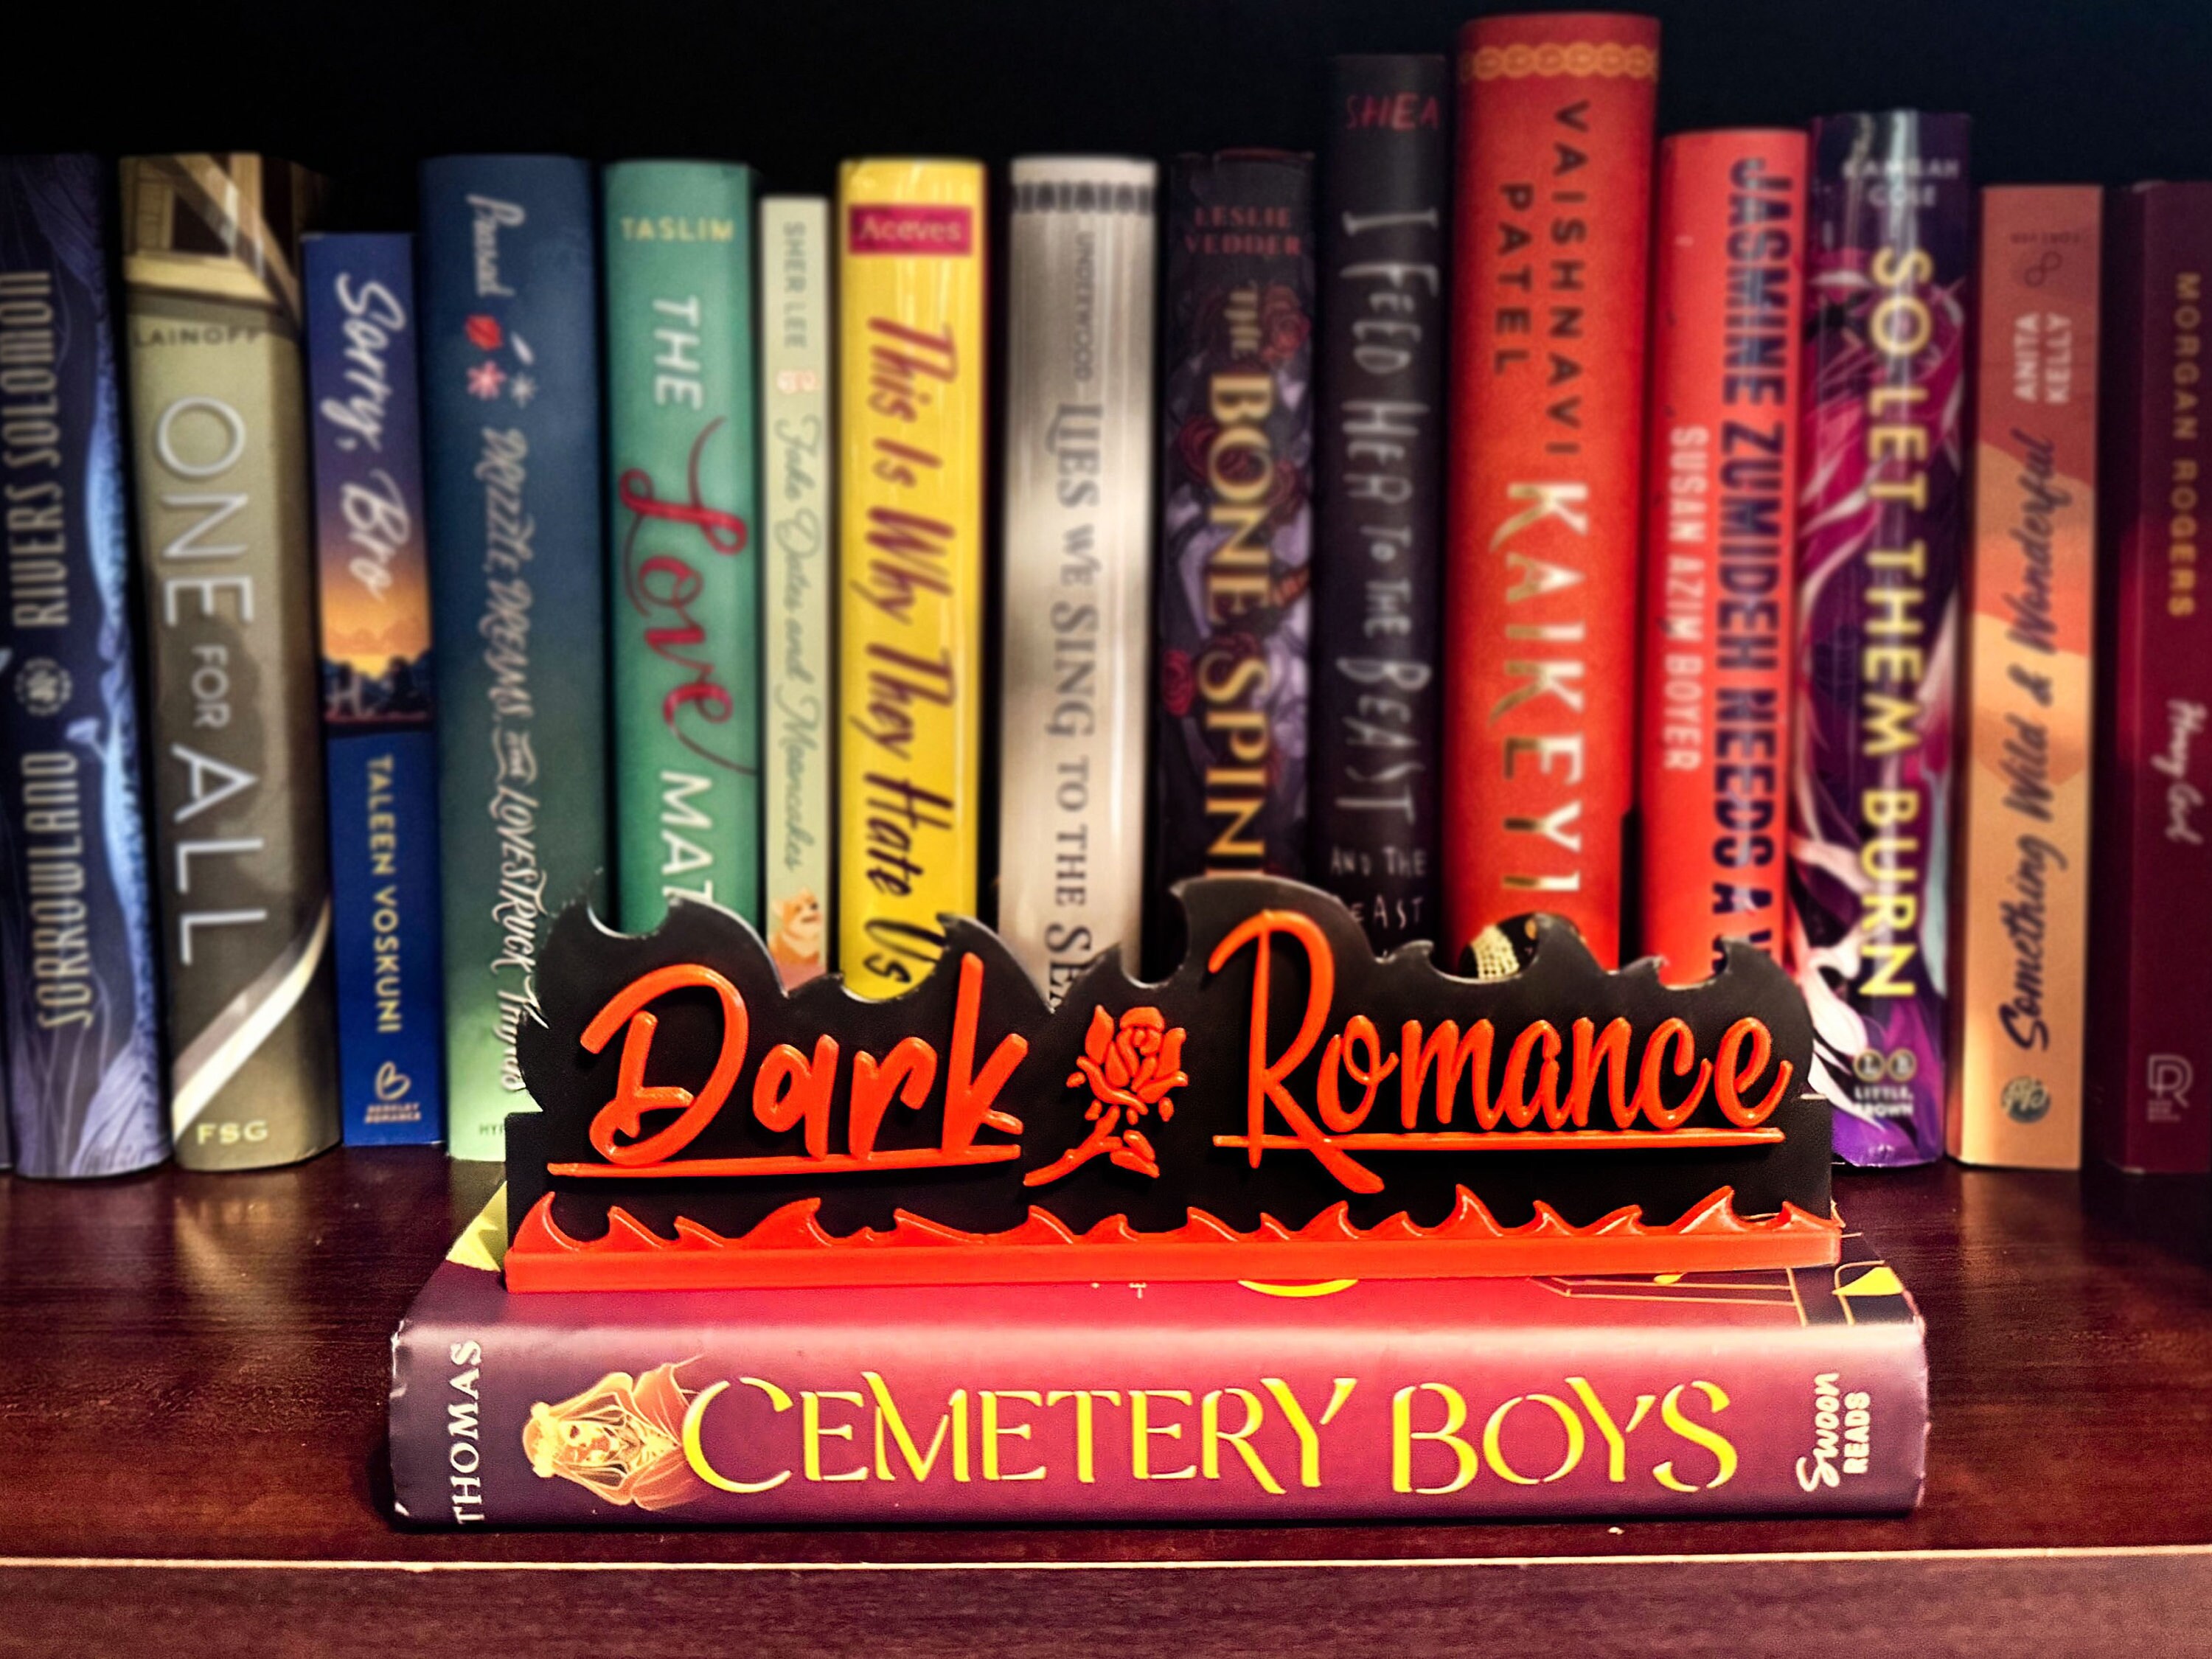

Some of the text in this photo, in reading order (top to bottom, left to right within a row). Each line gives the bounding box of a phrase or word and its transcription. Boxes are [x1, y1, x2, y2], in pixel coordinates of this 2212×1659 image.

[1346, 91, 1440, 131] SHEA
[621, 216, 734, 243] TASLIM
[783, 221, 807, 349] SHER LEE
[858, 216, 961, 244] Aceves
[1184, 233, 1302, 256] VEDDER
[1194, 206, 1290, 228] LESLIE
[1493, 181, 1535, 376] PATEL
[1545, 100, 1590, 456] VAISHNAVI
[1722, 157, 1792, 407] JASMINE
[133, 324, 260, 347] LAINOFF
[320, 272, 411, 602] Sorry, Bro
[2013, 312, 2039, 403] ANITA
[2044, 311, 2071, 404] KELLY
[0, 271, 69, 627] RIVERS SOLOMON
[1207, 374, 1274, 625] BONE
[1336, 208, 1439, 826] I FEED HER TO THE BEAST
[1717, 420, 1785, 672] ZUMIDEH
[2002, 426, 2073, 655] Wonderful
[2168, 273, 2202, 618] MORGAN ROGERS
[157, 395, 268, 965] ONE FOR ALL
[619, 296, 757, 904] THE Love MAT
[773, 414, 824, 873] Fake Dates and Mooncakes
[849, 317, 959, 984] This Is Why They Hate Us
[1488, 483, 1589, 891] KAIKEYI
[1663, 425, 1710, 771] SUSAN AZIM BOYER
[1857, 246, 1935, 998] SO LET THEM BURN
[2006, 663, 2054, 708] &
[1044, 404, 1104, 1006] LIES WE SING TO THE SE
[1198, 650, 1270, 877] SPIN
[1711, 688, 1777, 869] NEEDS
[1997, 712, 2055, 824] Wild
[2151, 699, 2207, 845] Honey Girl
[21, 751, 93, 1029] SORROWLAND
[366, 755, 403, 1033] TALEEN VOSKUNI
[1331, 846, 1427, 878] AND THE
[1351, 894, 1424, 930] EAST
[1712, 880, 1773, 914] A
[1997, 832, 2069, 1053] Something
[197, 1120, 269, 1144] FSG
[580, 909, 1792, 1194] Dark Romance
[451, 1339, 485, 1525] THOMAS
[682, 1371, 1739, 1495] CEMETERY BOYS
[1796, 1372, 1840, 1493] Swoon
[1843, 1391, 1871, 1475] READS
